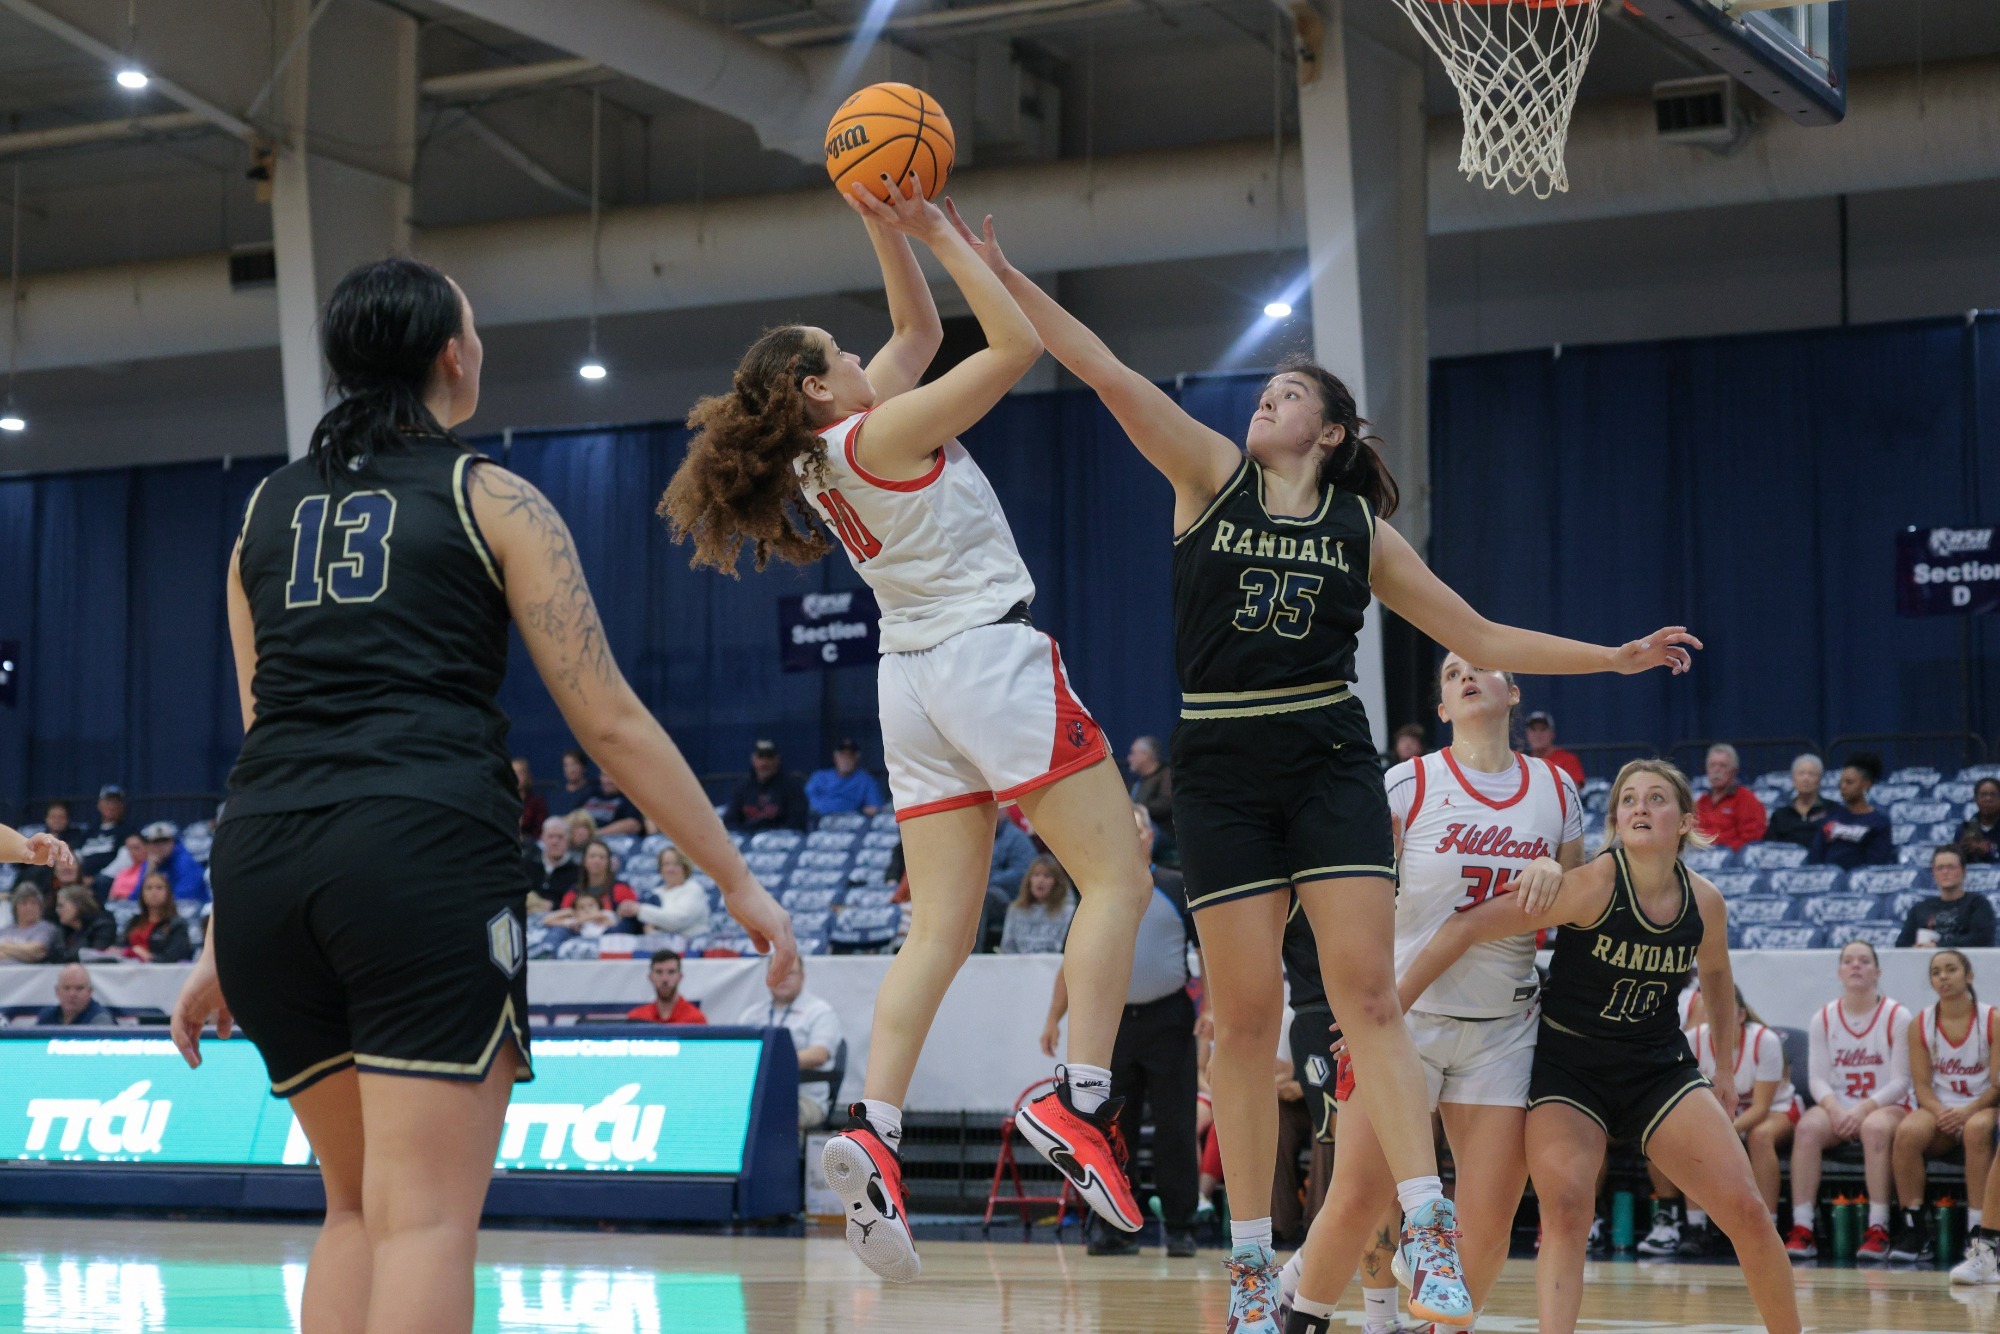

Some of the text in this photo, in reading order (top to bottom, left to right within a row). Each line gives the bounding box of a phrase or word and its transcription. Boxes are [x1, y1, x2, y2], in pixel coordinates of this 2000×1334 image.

[285, 489, 398, 609] 13
[1211, 519, 1350, 573] RANDALL
[1232, 567, 1324, 640] 35
[1952, 585, 1971, 606] D
[792, 621, 867, 645] Section
[821, 643, 838, 663] C
[1435, 822, 1551, 860] Hillcats
[1592, 933, 1696, 973] RANDALL
[1600, 978, 1668, 1022] 10
[1834, 1048, 1884, 1067] Hillcats
[1845, 1071, 1876, 1098] 22
[26, 1098, 172, 1154] TTCU
[504, 1103, 666, 1161] TTCU
